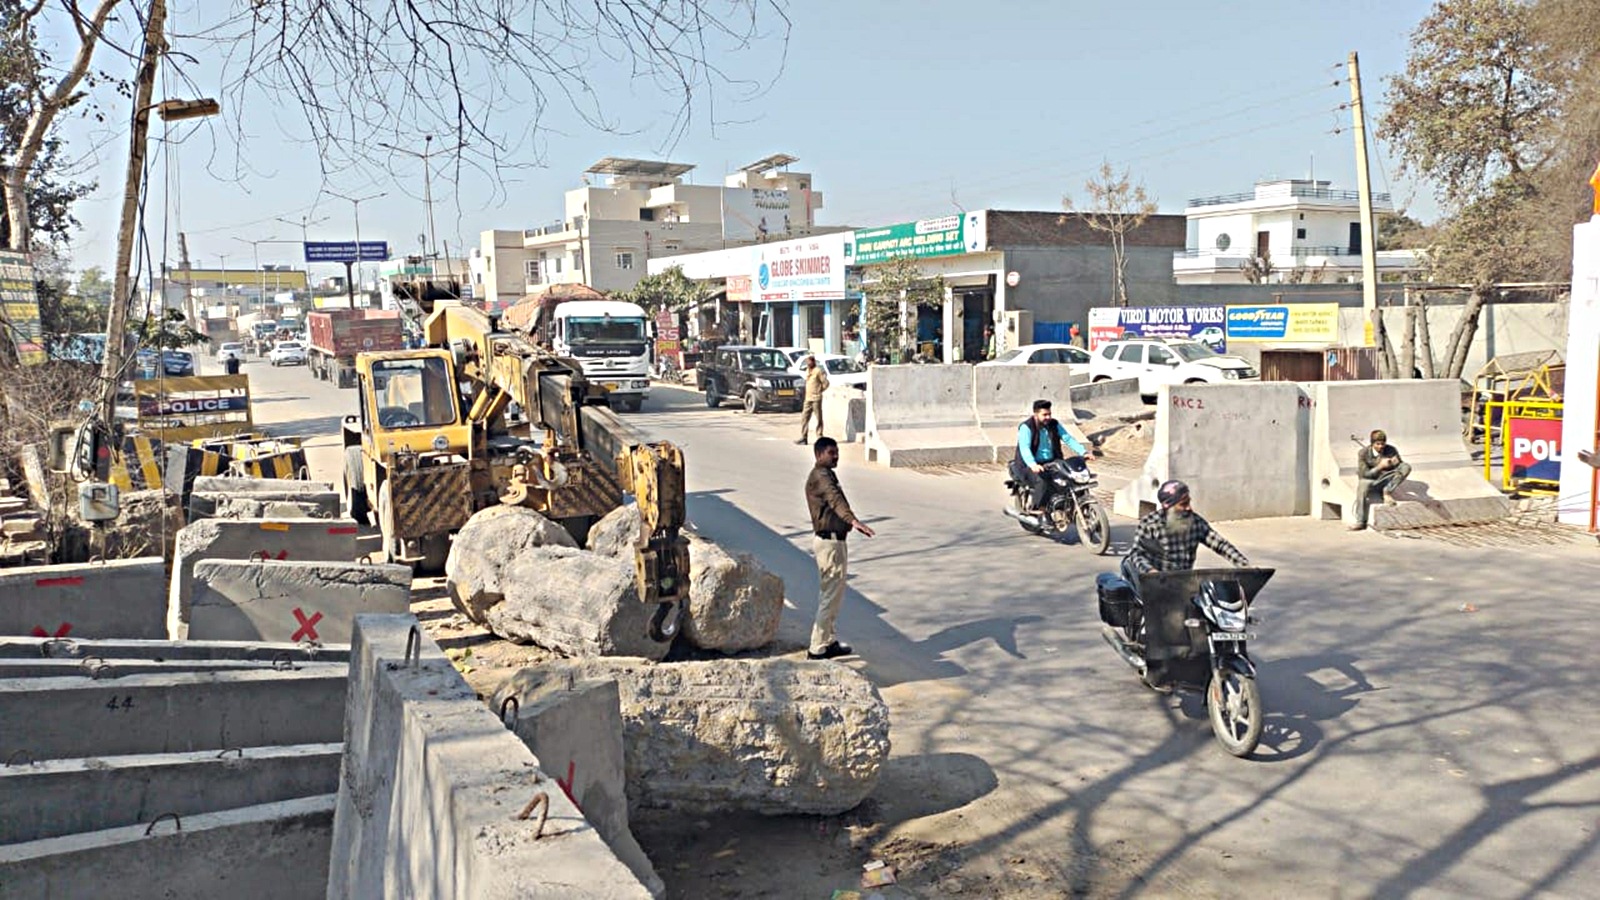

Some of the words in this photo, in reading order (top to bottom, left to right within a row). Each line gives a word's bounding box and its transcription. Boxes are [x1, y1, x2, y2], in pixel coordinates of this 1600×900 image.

[945, 230, 960, 242] SET
[770, 259, 794, 279] GLOBE
[795, 255, 831, 276] SKIMMER
[1120, 308, 1147, 323] VIRDI
[1149, 308, 1184, 323] MOTOR
[1186, 307, 1224, 323] WORKS
[1229, 309, 1285, 323] GOODYEAR
[157, 399, 230, 413] POLICE
